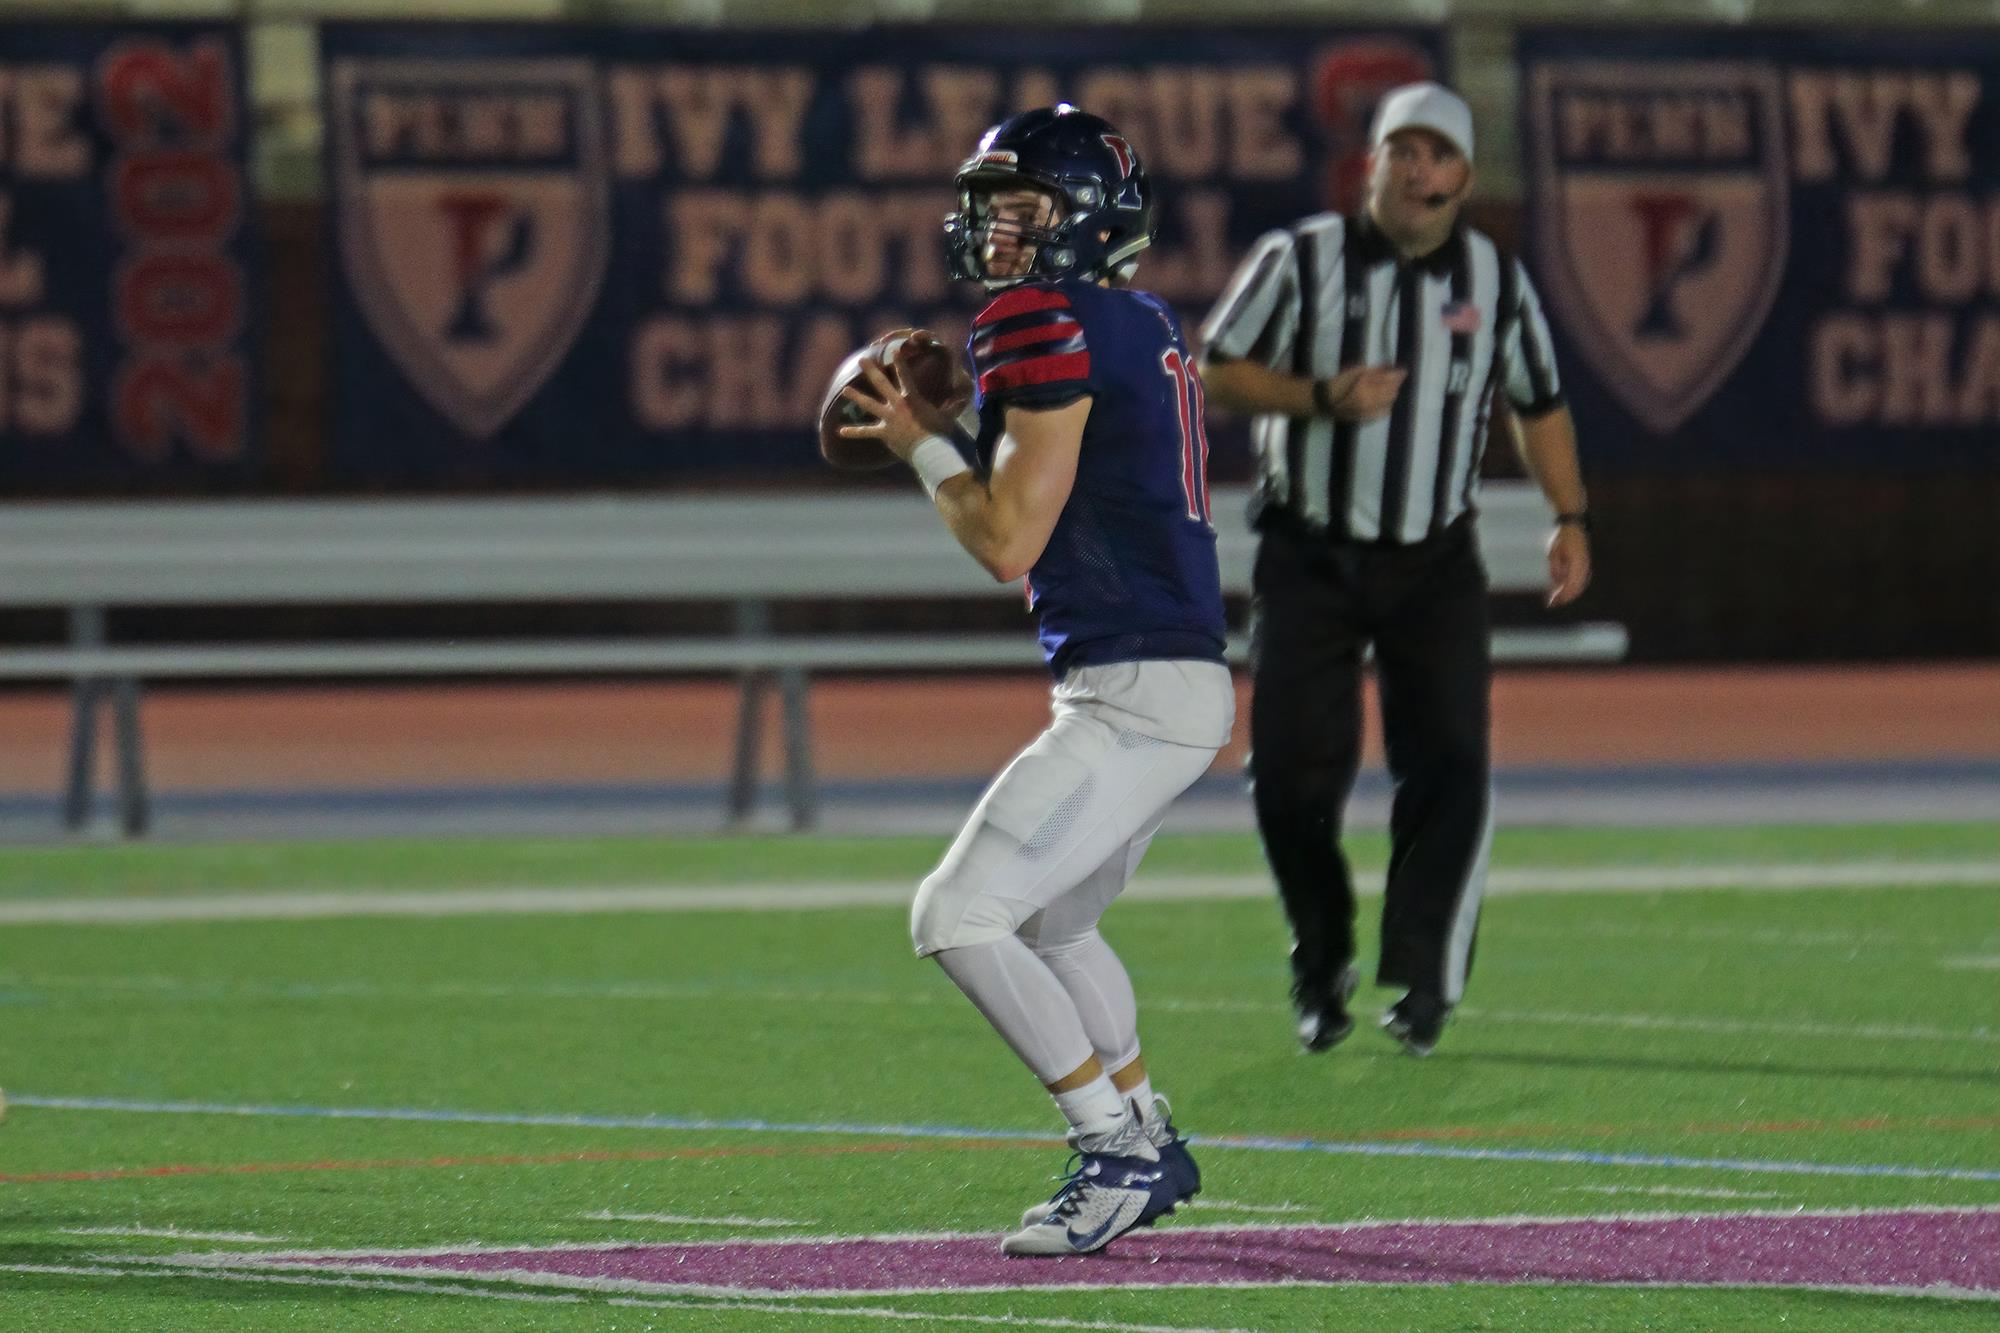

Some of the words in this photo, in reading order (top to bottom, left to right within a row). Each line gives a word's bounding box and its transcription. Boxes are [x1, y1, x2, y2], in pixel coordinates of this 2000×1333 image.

[607, 64, 814, 178] IVY
[1789, 68, 1982, 181] IVY
[1848, 194, 2000, 298] FO
[1161, 347, 1214, 528] 11
